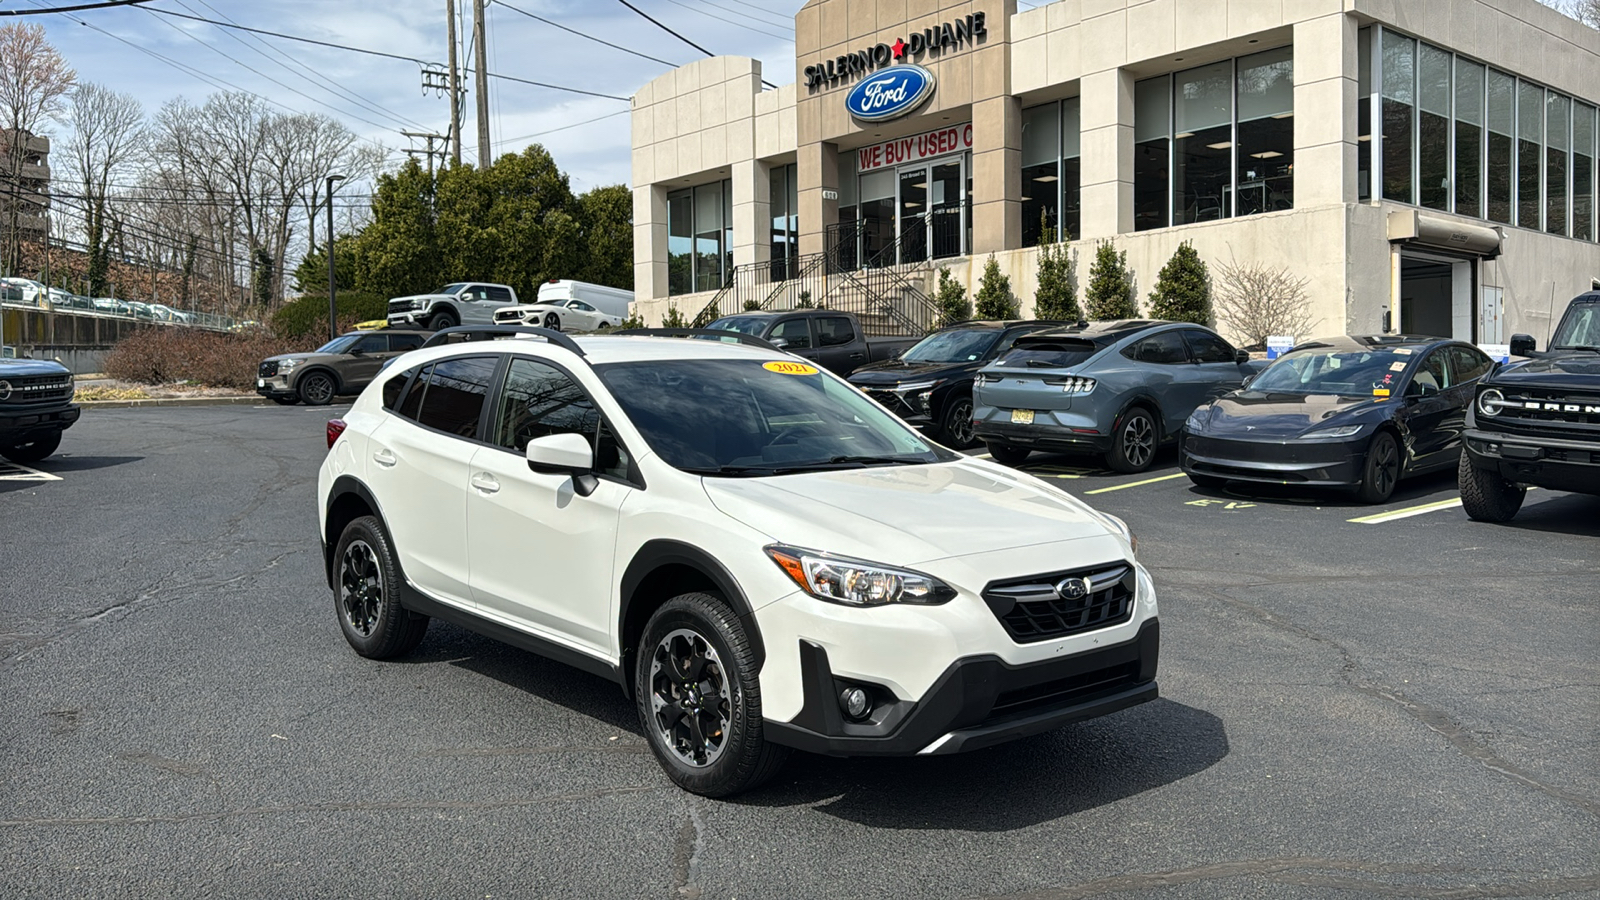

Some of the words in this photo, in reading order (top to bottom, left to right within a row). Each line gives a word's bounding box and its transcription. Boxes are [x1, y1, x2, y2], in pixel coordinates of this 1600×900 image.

[804, 43, 891, 86] SALERNO
[909, 11, 986, 55] DUANE
[861, 77, 908, 111] Ford
[860, 146, 882, 170] WE
[885, 138, 914, 165] BUY
[918, 129, 958, 157] USED
[774, 363, 808, 372] 2021
